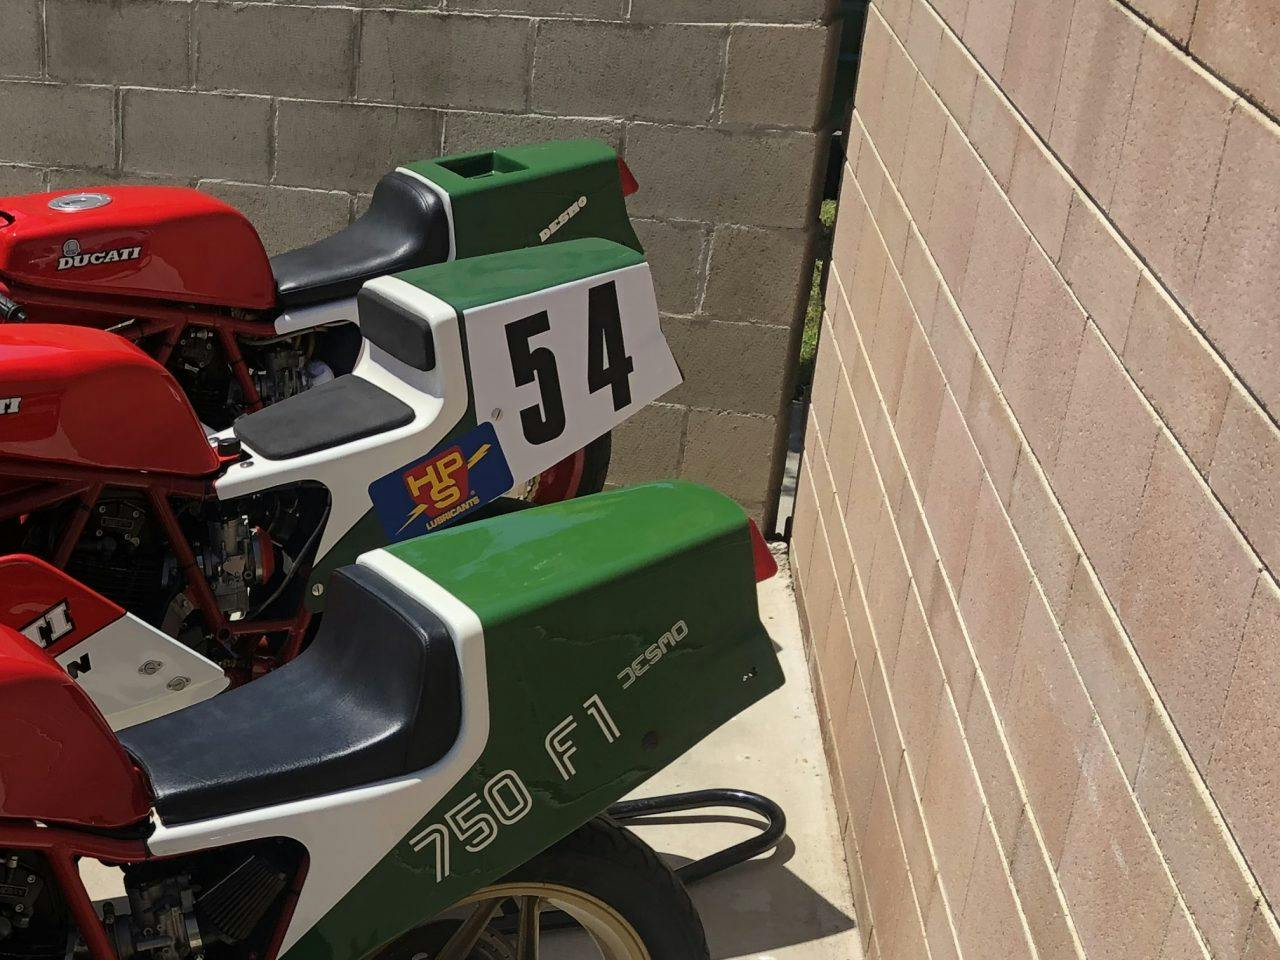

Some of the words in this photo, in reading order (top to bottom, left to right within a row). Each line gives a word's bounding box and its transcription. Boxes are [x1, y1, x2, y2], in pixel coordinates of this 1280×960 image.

[539, 196, 587, 242] DESMO
[58, 247, 141, 270] DUCATI
[504, 280, 634, 445] 54
[425, 496, 480, 530] LUBRICANTS
[617, 619, 688, 690] DESMO
[409, 769, 533, 883] 750
[544, 694, 621, 781] F1
